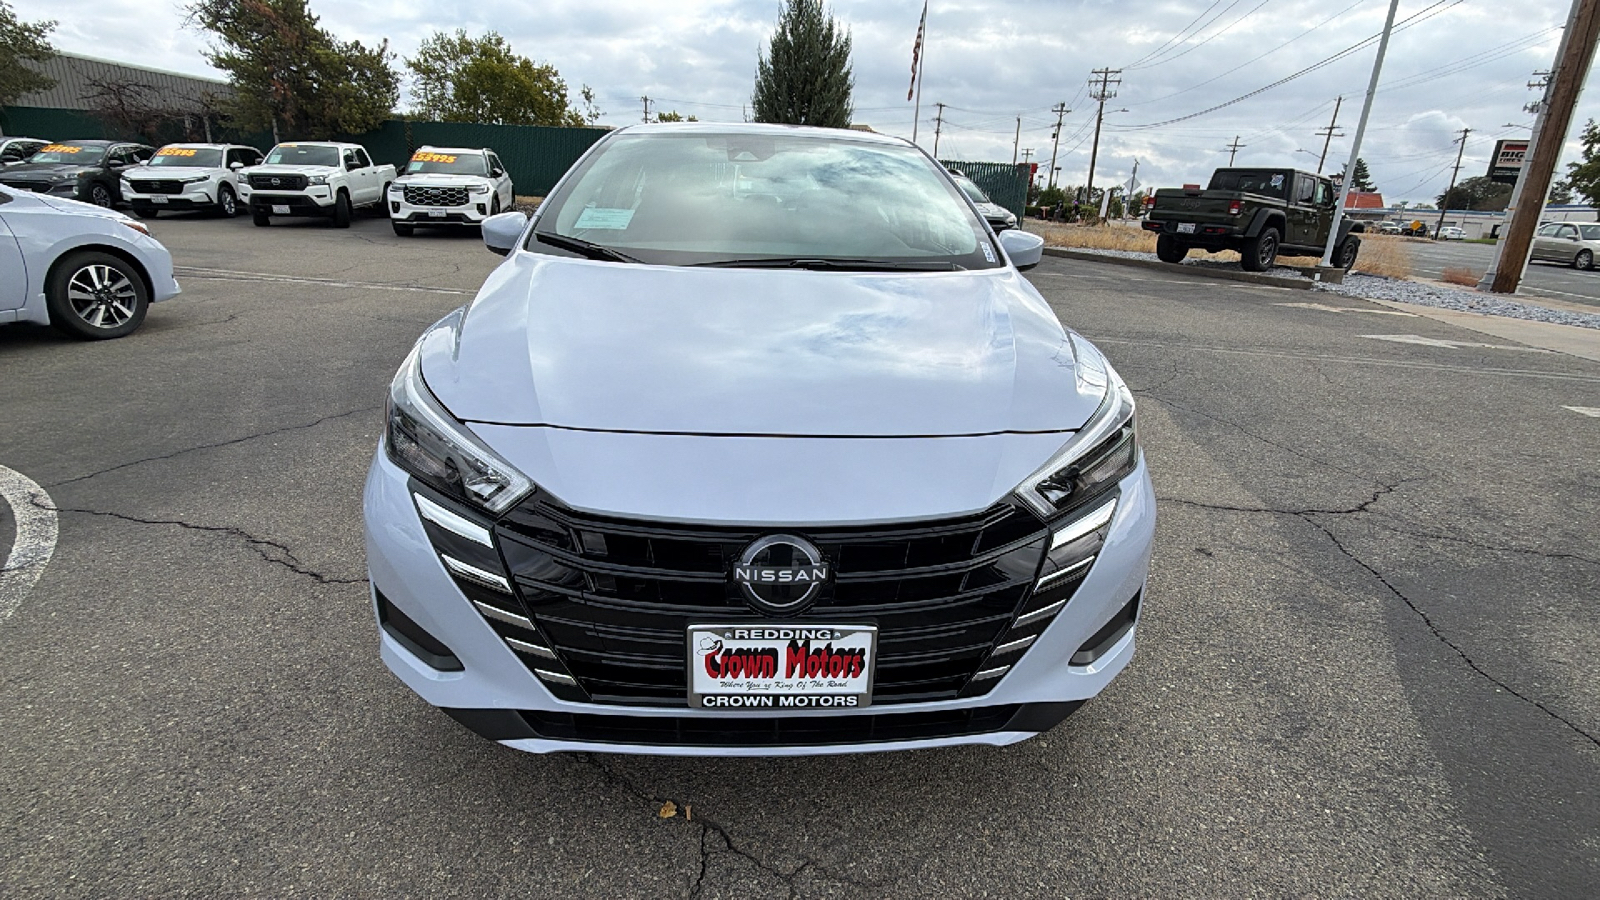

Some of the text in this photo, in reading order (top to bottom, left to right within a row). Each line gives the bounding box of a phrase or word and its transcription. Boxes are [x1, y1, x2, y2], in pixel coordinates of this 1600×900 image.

[736, 568, 826, 582] NISSAN
[735, 629, 831, 639] REDDING
[705, 640, 866, 679] Crown Motors
[796, 681, 807, 690] Of
[810, 680, 824, 688] The
[703, 696, 858, 707] CROWN MOTORS
